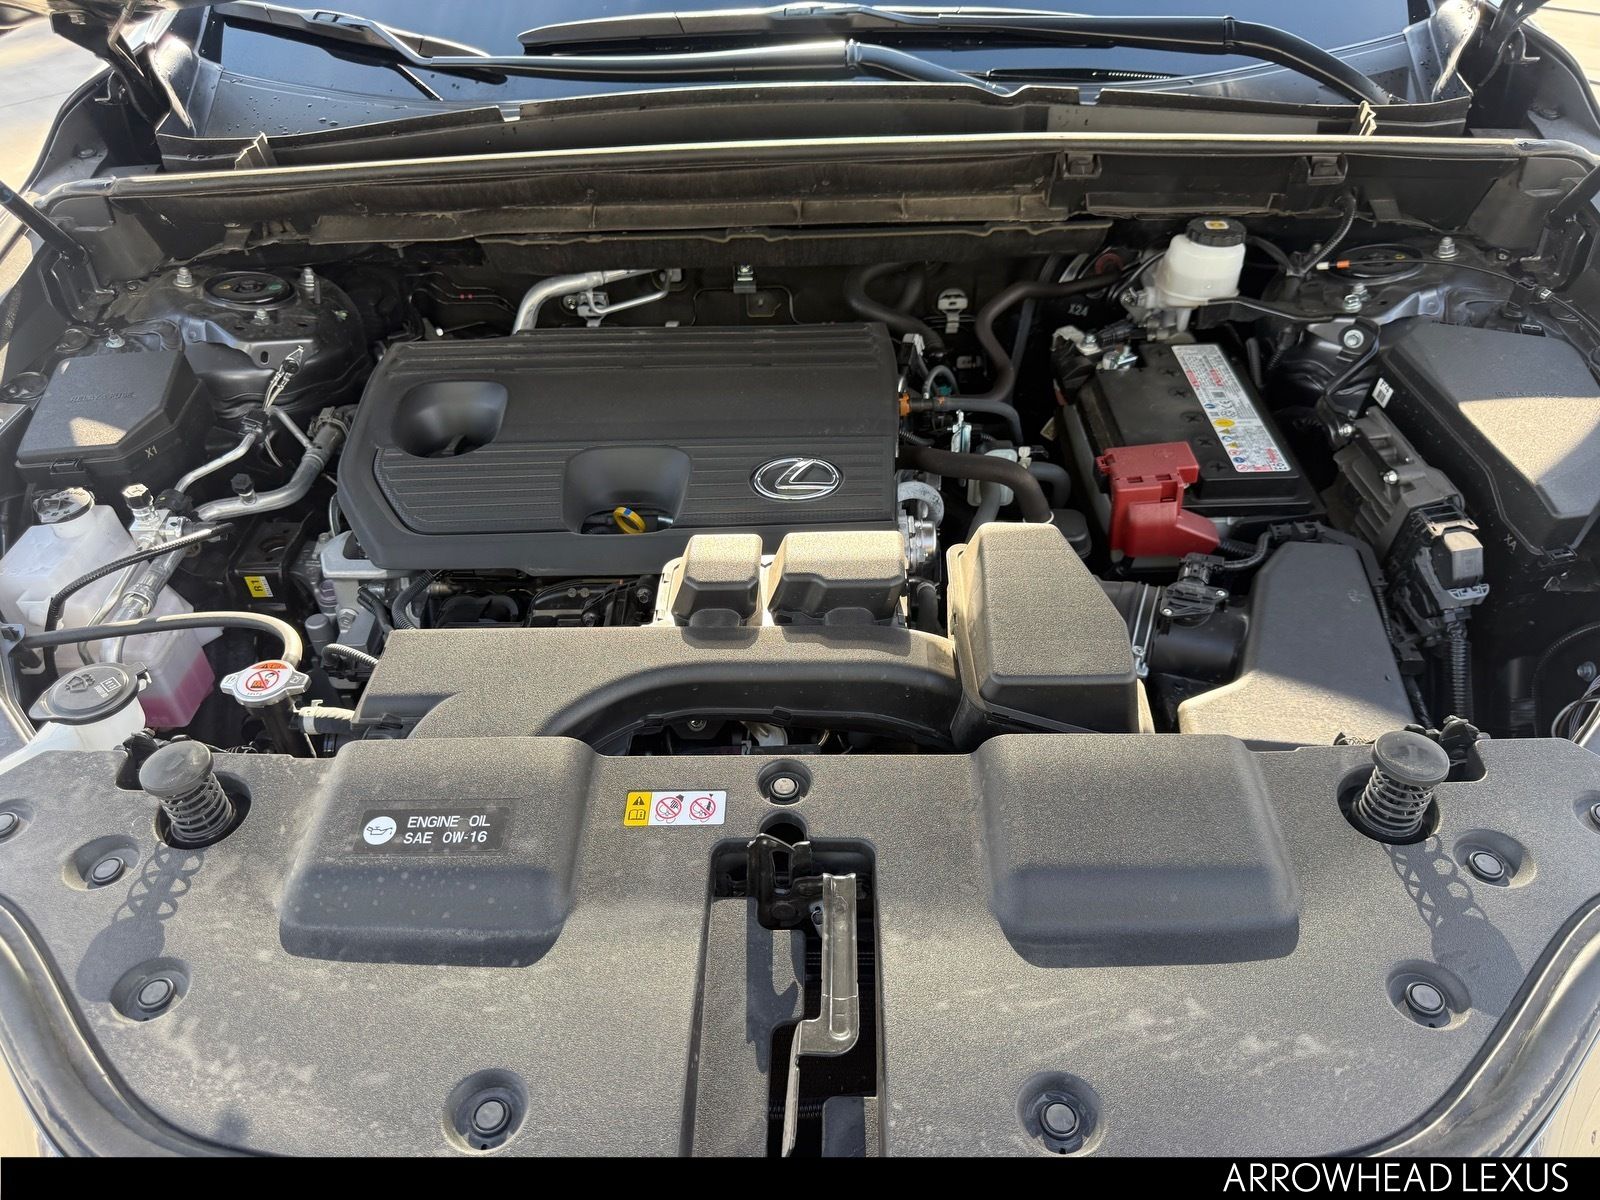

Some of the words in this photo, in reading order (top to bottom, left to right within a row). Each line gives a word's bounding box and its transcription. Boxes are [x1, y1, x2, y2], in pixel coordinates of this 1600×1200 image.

[144, 444, 158, 458] X1
[407, 815, 460, 828] ENGINE
[468, 814, 491, 827] OIL
[403, 831, 434, 844] SAE
[442, 830, 488, 843] 0W-16
